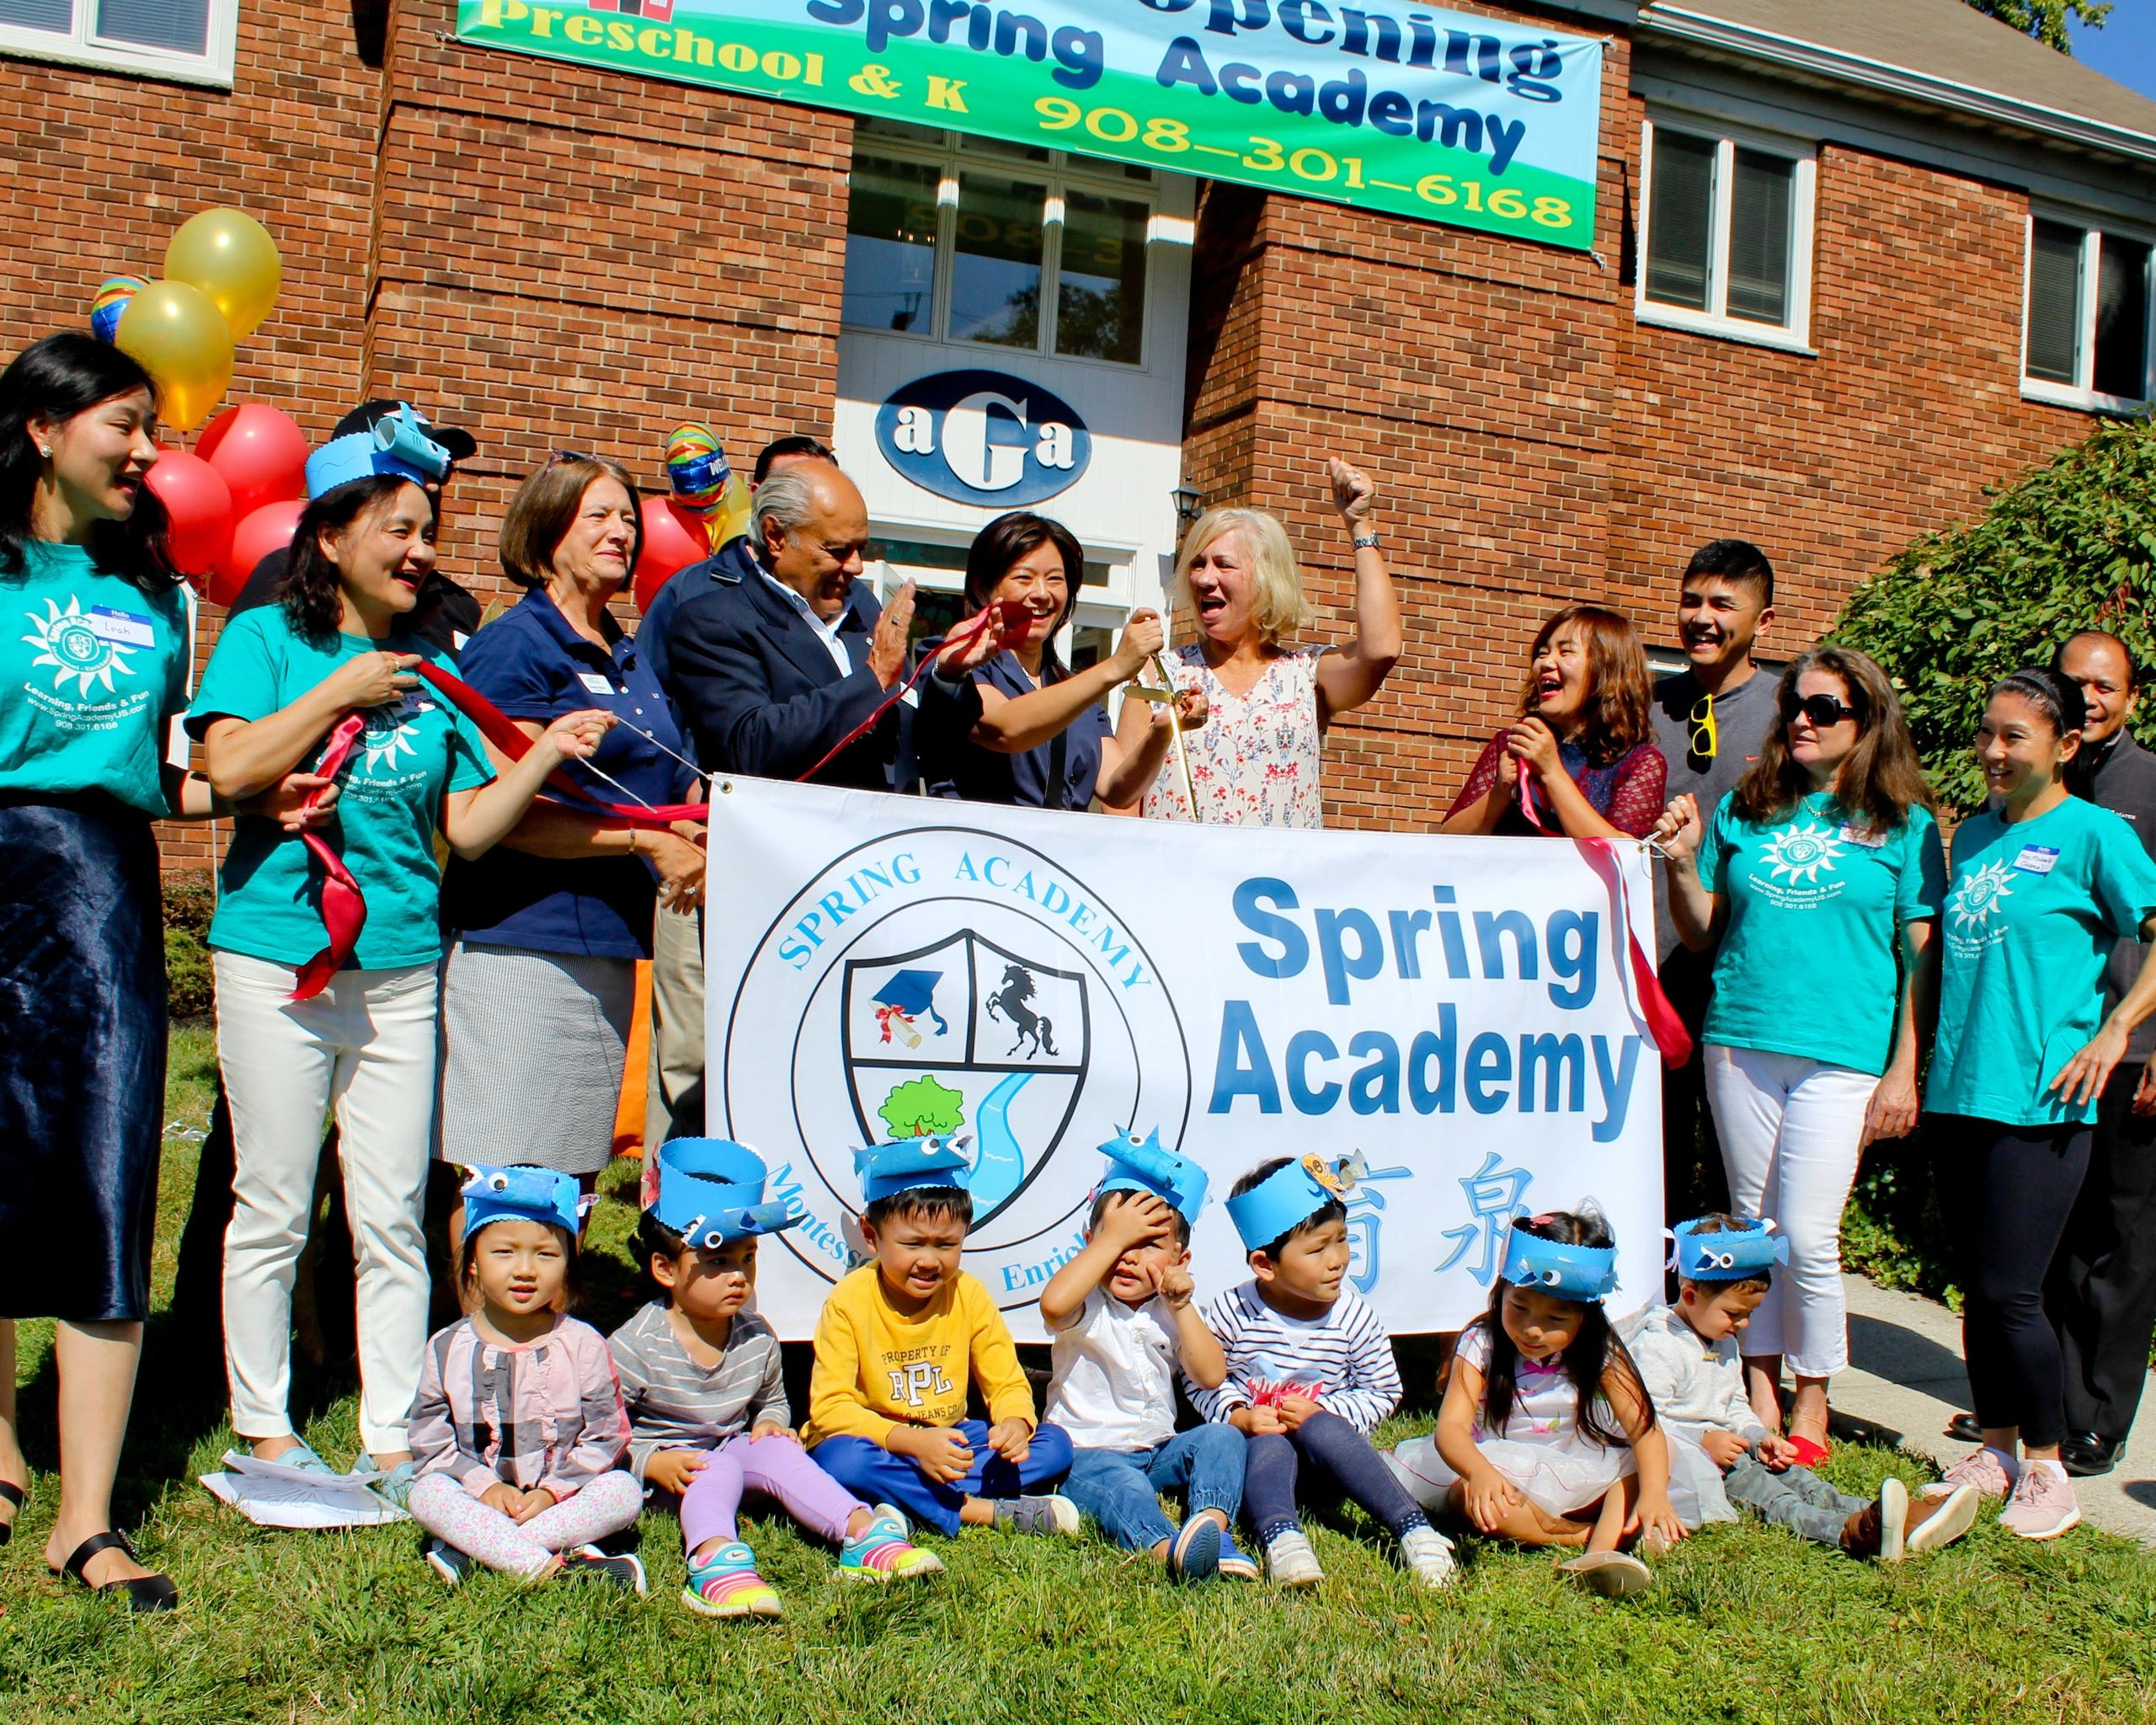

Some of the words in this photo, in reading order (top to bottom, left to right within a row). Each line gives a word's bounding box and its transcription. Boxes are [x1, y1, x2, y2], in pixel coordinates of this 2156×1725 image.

[477, 0, 824, 87] Preschool
[848, 64, 903, 99] &
[925, 76, 969, 114] K
[1137, 0, 1562, 103] pening
[1156, 36, 1525, 176] Academy
[894, 391, 1075, 492] aGa
[24, 681, 74, 712] Learning,
[77, 702, 117, 713] Friends
[120, 698, 130, 708] &
[130, 690, 150, 703] Fun
[363, 777, 398, 788] Friends
[409, 771, 427, 782] Fun
[778, 852, 921, 970] SPRING
[954, 851, 1151, 992] ACADEMY
[1828, 880, 1846, 890] Fun
[1232, 877, 1599, 1010] Spring
[1208, 1000, 1642, 1142] Academy
[881, 1345, 937, 1365] PROPERTY
[888, 1361, 953, 1407] RPL
[915, 1407, 946, 1420] JEANS
